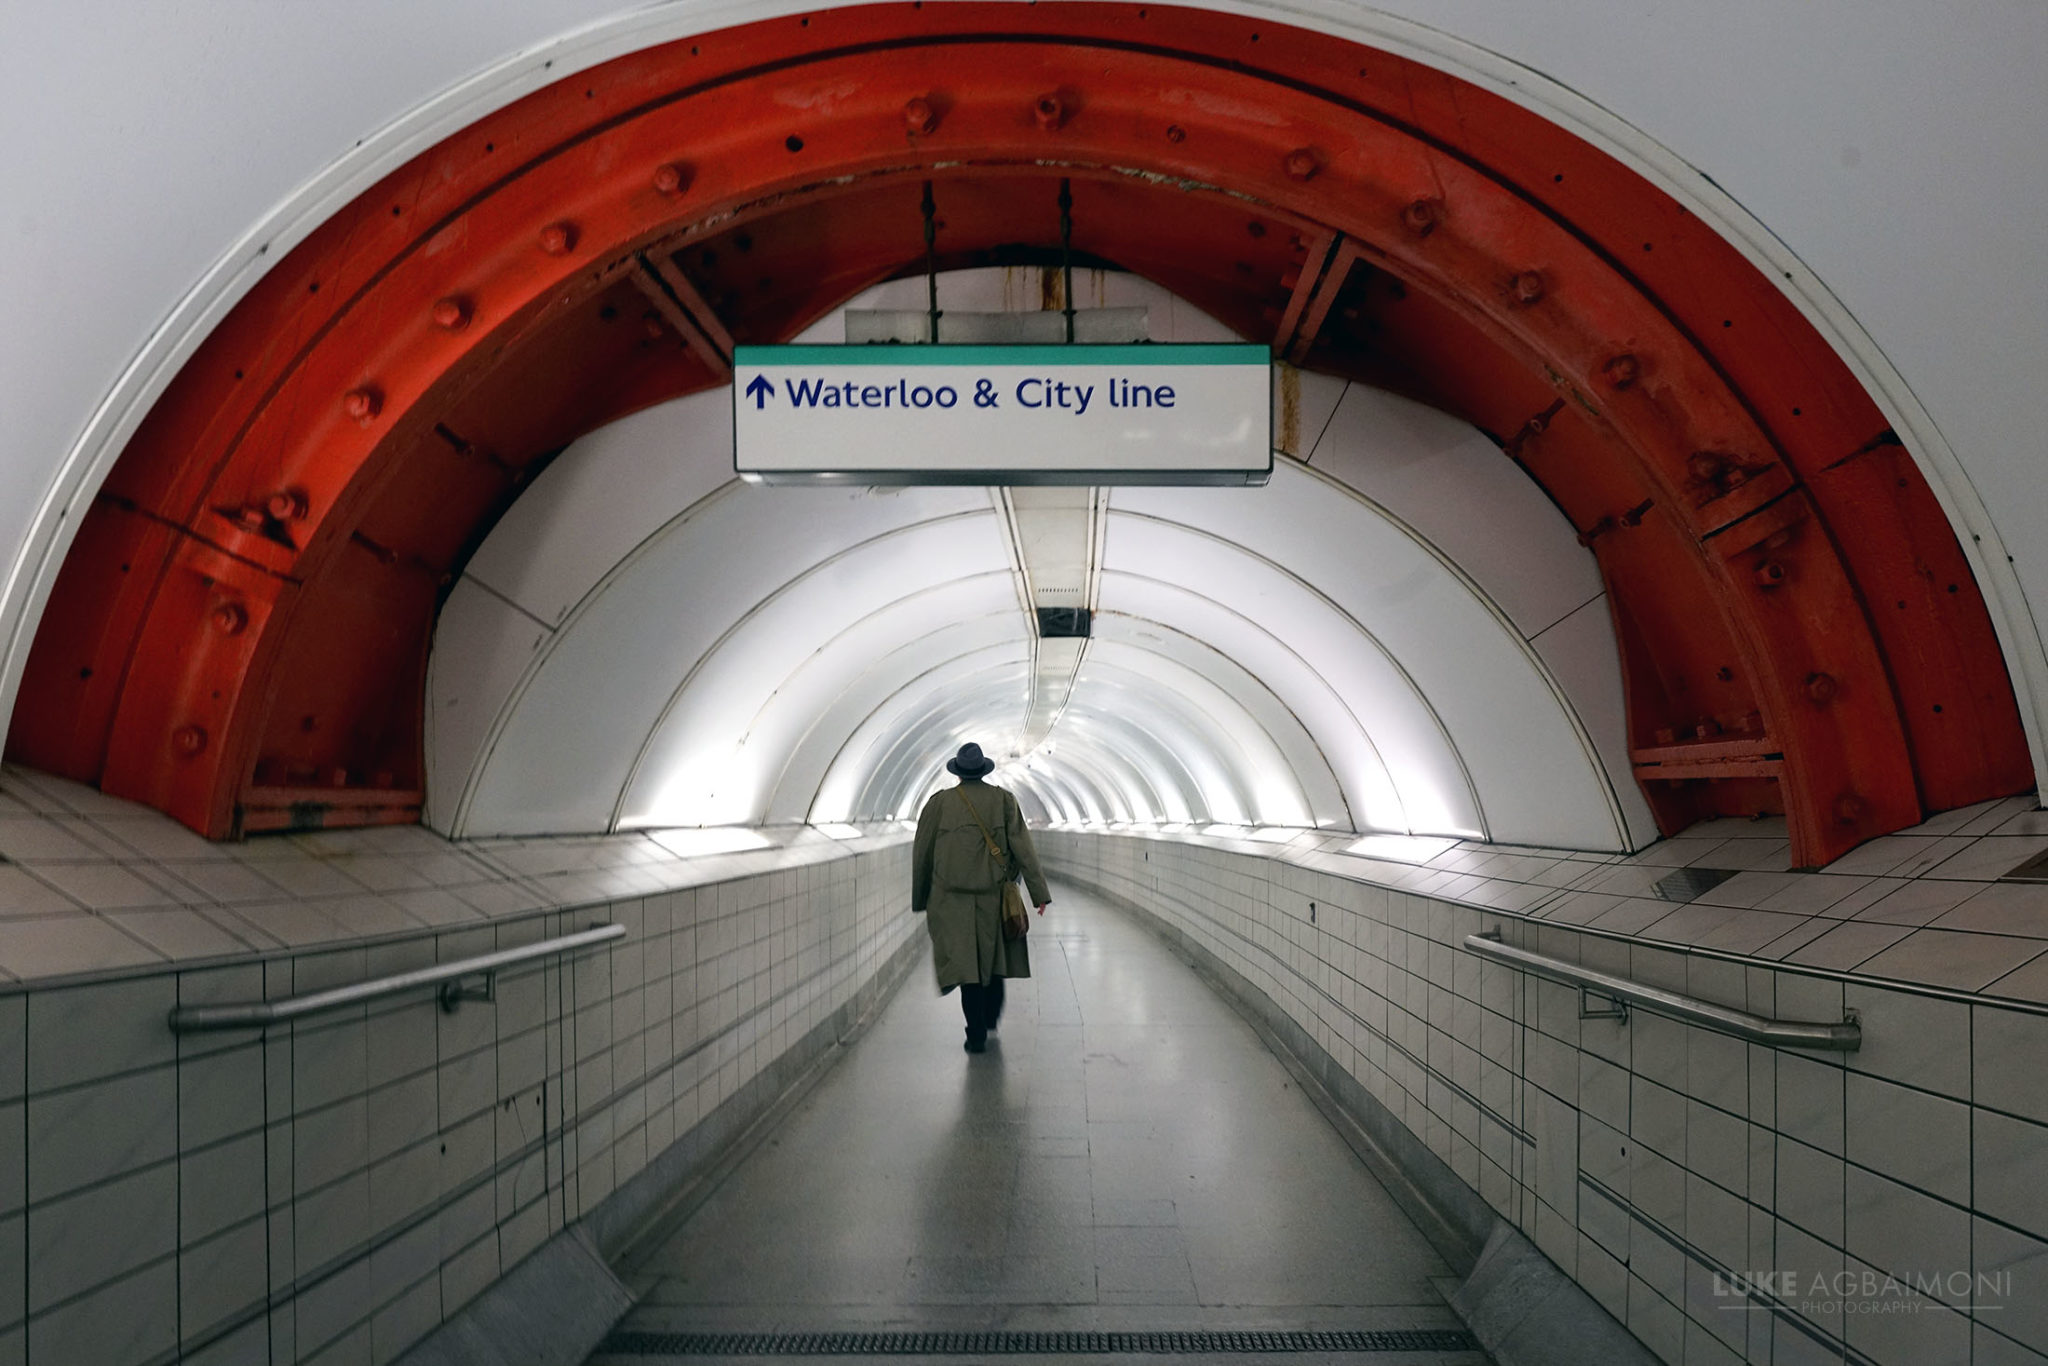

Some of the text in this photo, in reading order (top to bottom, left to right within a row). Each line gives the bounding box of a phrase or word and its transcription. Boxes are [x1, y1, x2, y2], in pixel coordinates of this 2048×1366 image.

[785, 377, 1176, 414] Waterloo & City line
